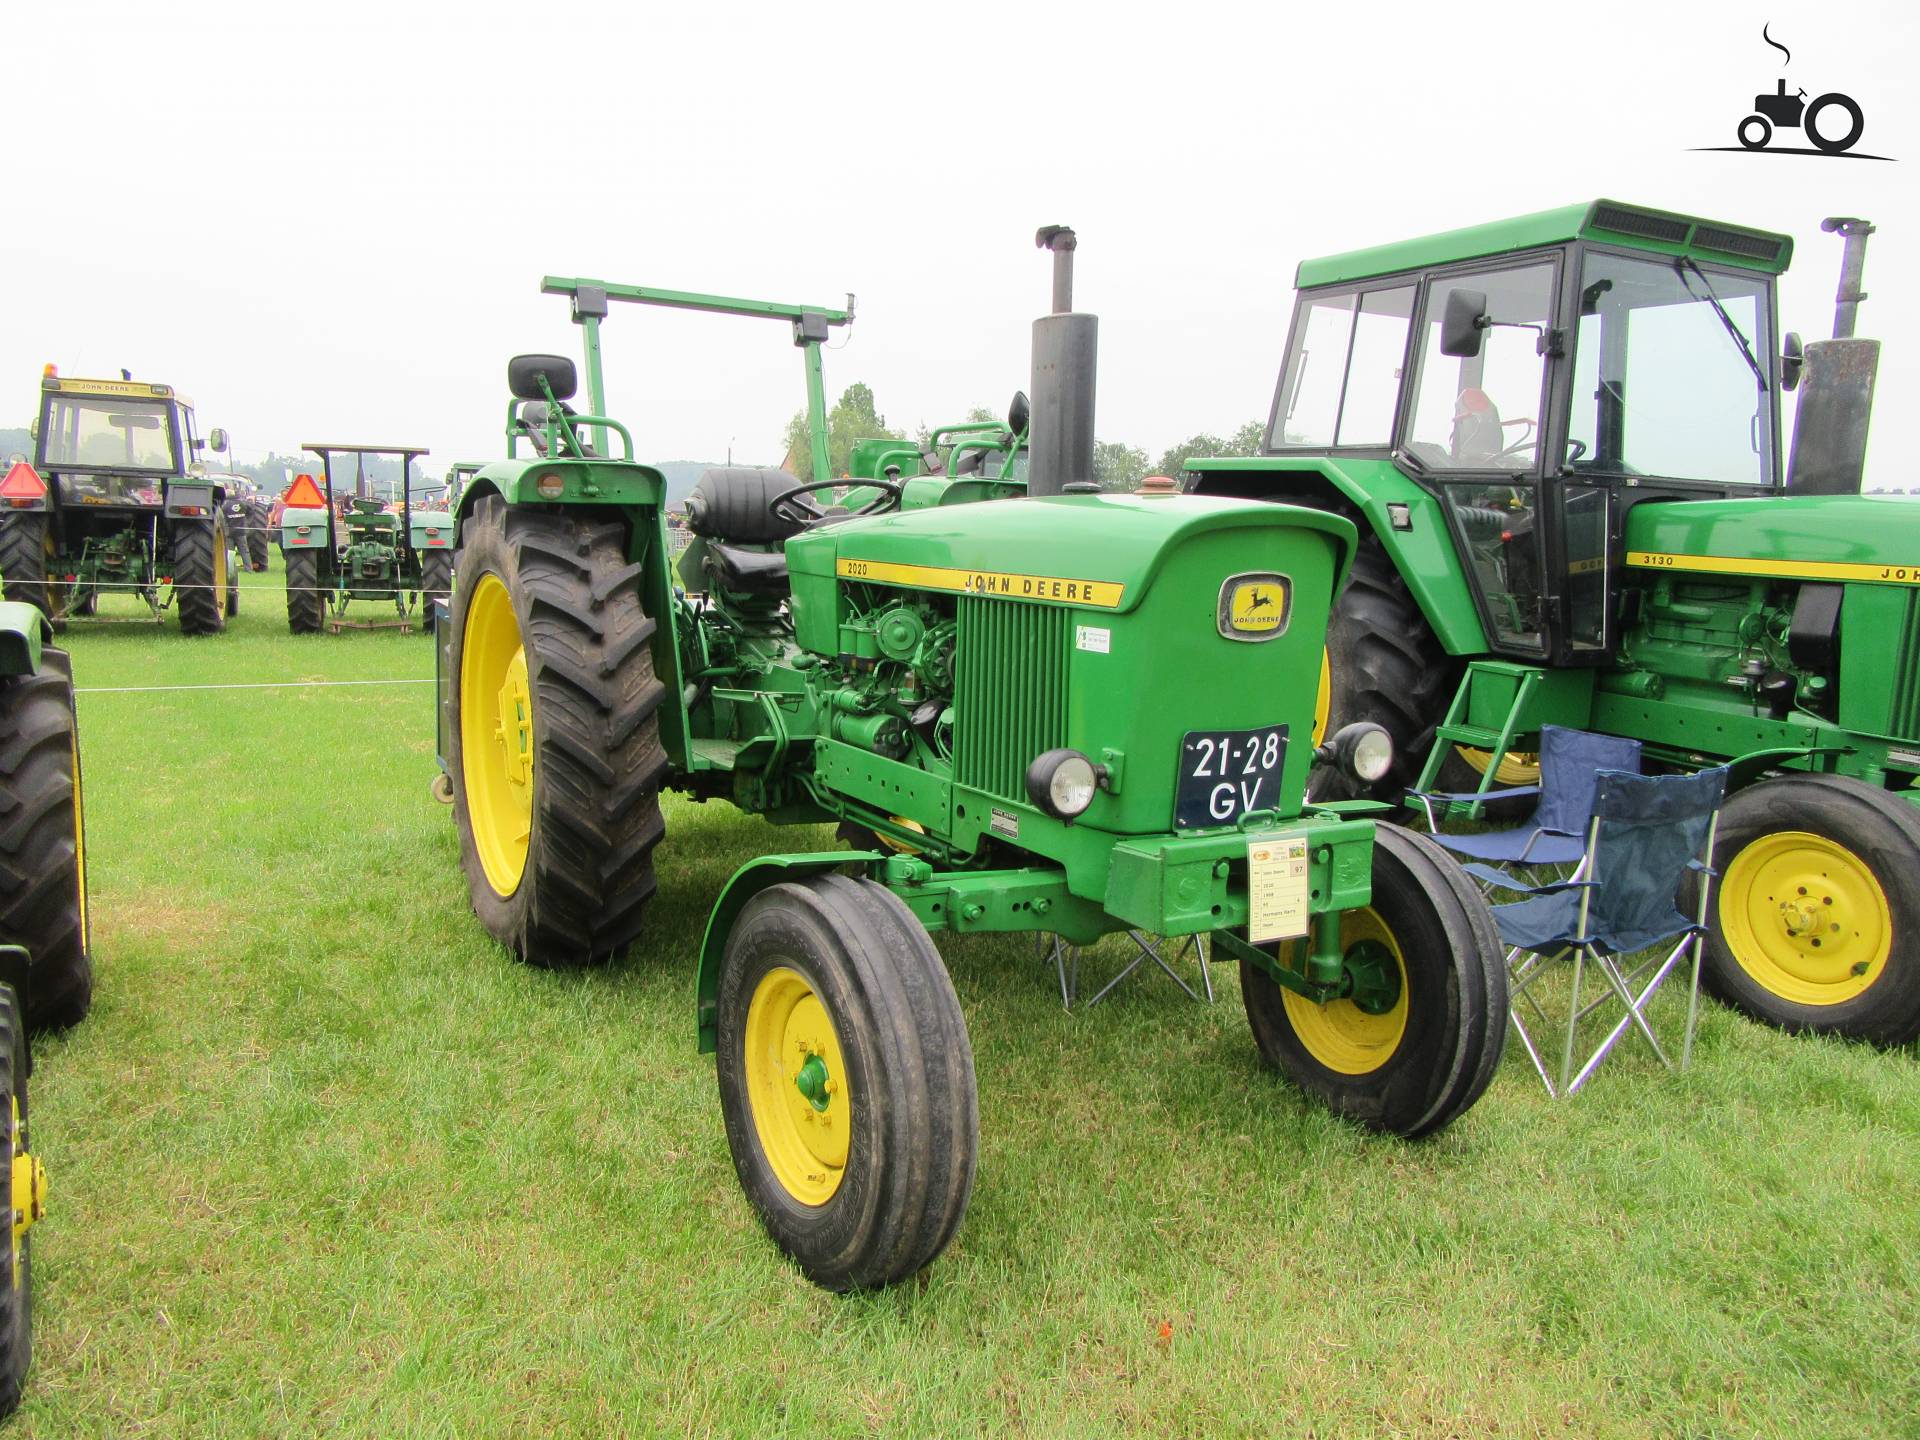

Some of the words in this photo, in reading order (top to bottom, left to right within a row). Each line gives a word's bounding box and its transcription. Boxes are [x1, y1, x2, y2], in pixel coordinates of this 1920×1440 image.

[848, 562, 867, 576] 2020
[1643, 556, 1673, 565] 3130
[965, 575, 1010, 593] JOHN
[1023, 580, 1093, 601] DEERE
[1192, 733, 1279, 776] 21-28
[1209, 777, 1262, 819] GV
